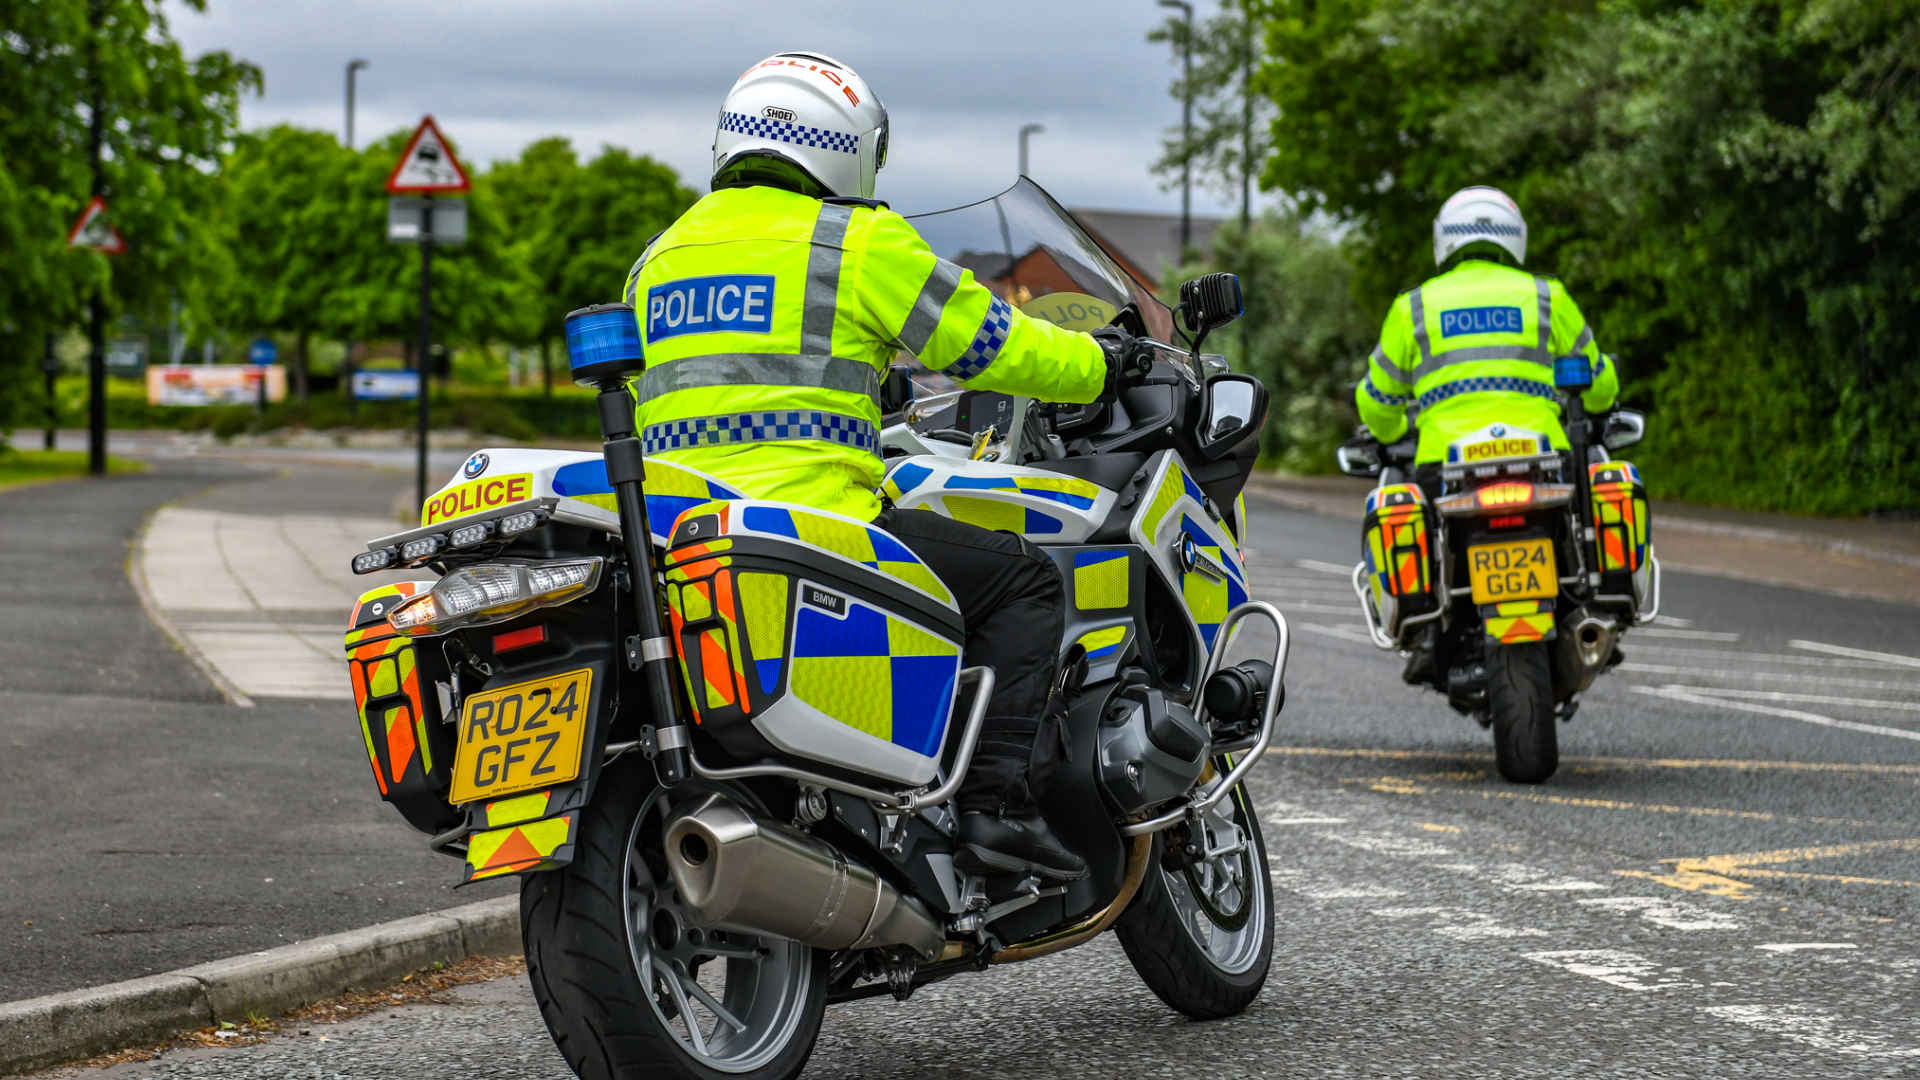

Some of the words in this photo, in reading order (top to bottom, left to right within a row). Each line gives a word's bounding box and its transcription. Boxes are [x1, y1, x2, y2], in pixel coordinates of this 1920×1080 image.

[766, 108, 793, 121] SHOEI
[649, 284, 767, 333] POLICE
[1444, 309, 1519, 332] POLICE
[1468, 440, 1533, 460] POLICE
[428, 477, 526, 525] POLICE
[1474, 545, 1547, 572] RO24
[1487, 570, 1541, 595] GGA
[813, 591, 837, 608] BMW
[466, 680, 579, 744] RO24
[474, 731, 560, 787] GFZ
